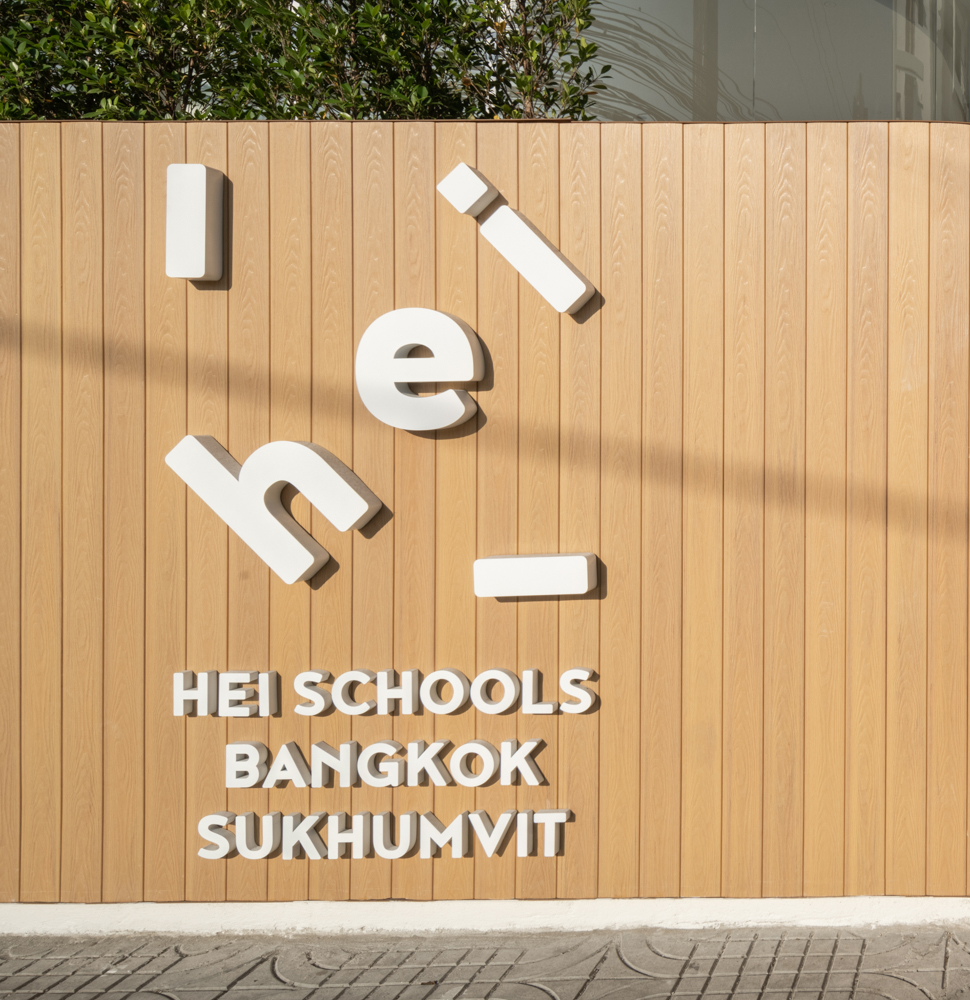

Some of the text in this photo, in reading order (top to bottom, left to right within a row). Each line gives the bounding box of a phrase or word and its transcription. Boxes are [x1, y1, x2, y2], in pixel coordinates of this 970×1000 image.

[172, 668, 599, 717] HEI SCHOOLS
[225, 740, 545, 788] BANGKOK
[197, 810, 573, 860] SUKHUMVIT
